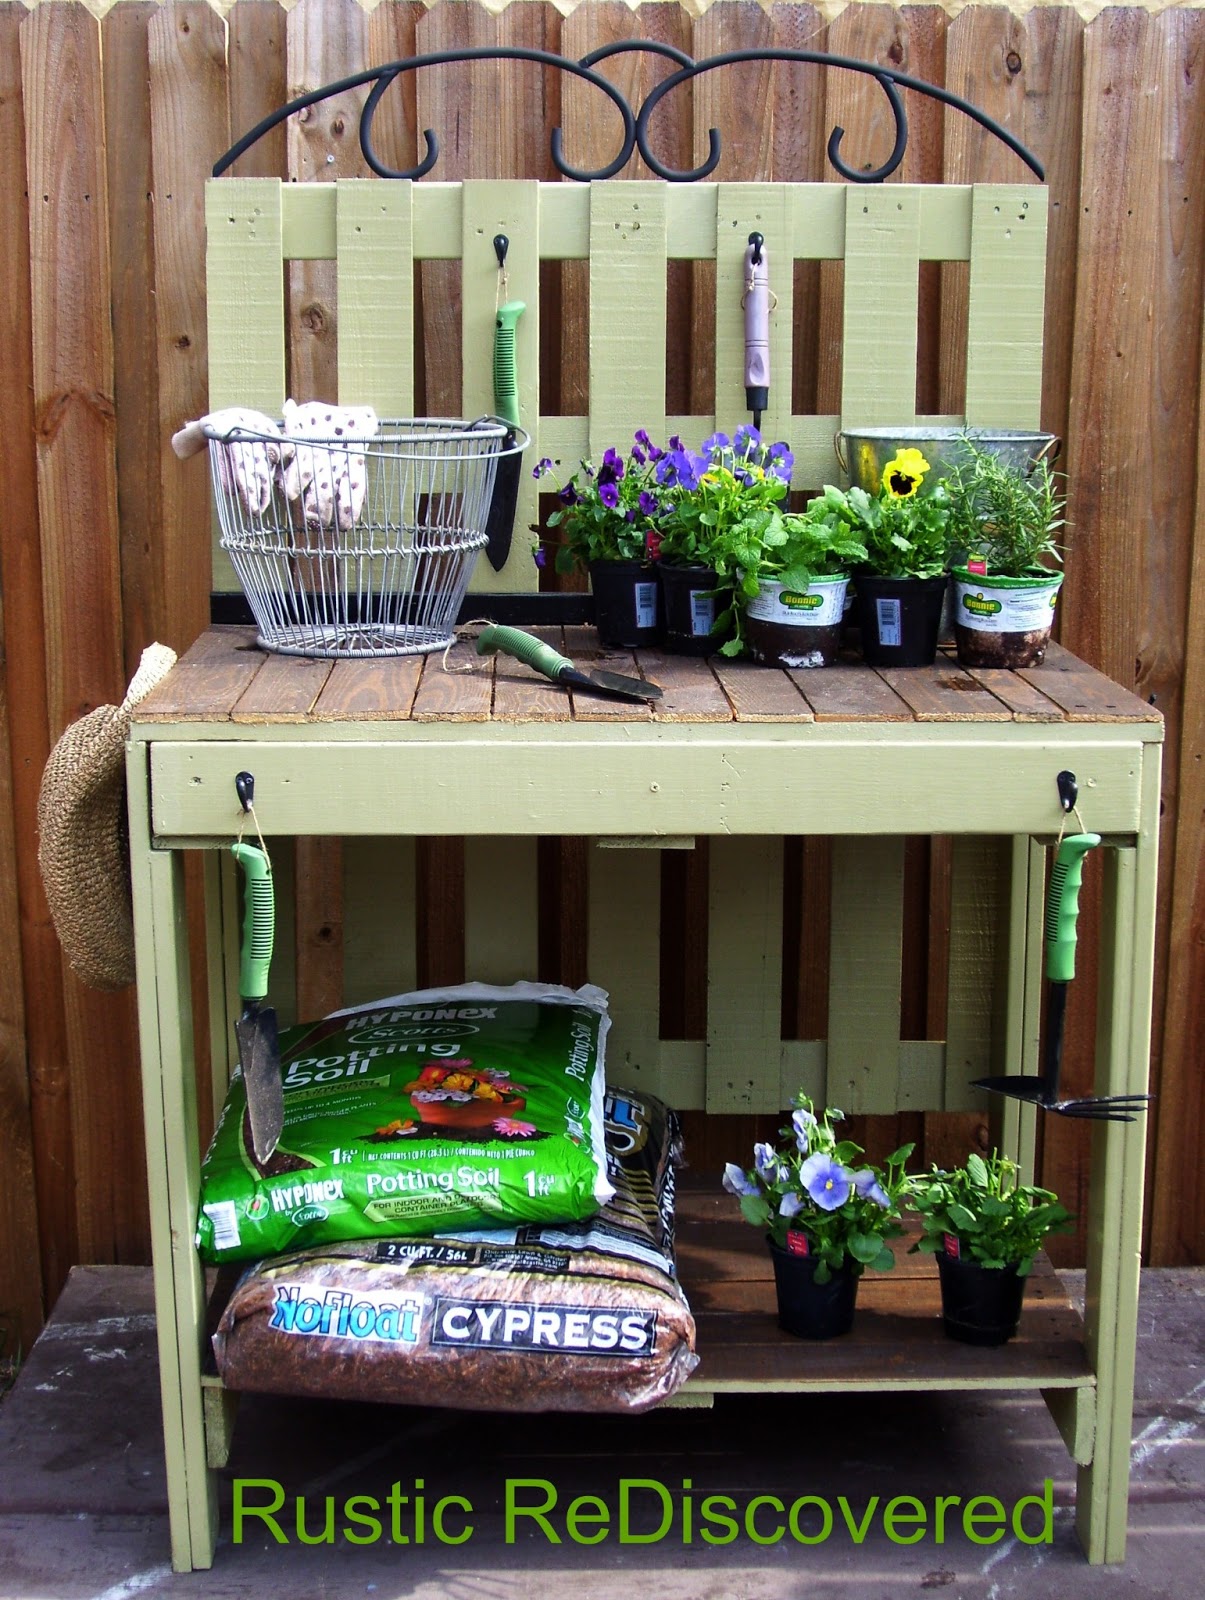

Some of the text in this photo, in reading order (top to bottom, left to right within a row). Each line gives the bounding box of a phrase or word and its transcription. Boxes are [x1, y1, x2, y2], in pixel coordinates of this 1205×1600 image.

[367, 1026, 460, 1040] Scotts
[570, 1022, 593, 1042] Soil
[287, 1043, 461, 1075] Potting
[565, 1039, 595, 1082] Potting
[282, 1058, 371, 1089] Soil
[329, 1147, 342, 1165] 1
[380, 1151, 407, 1161] CONTENTS
[455, 1147, 486, 1157] CONTENIDO
[486, 1150, 501, 1160] NETO
[505, 1149, 514, 1159] PIE
[367, 1165, 501, 1195] Potting Soil
[522, 1169, 537, 1198] 1
[373, 1202, 392, 1210] FOR
[394, 1197, 430, 1208] INDOOR
[394, 1202, 448, 1214] CONTAINER
[387, 1244, 396, 1256] 2
[446, 1249, 468, 1261] 56L
[441, 1306, 648, 1350] CYPRESS
